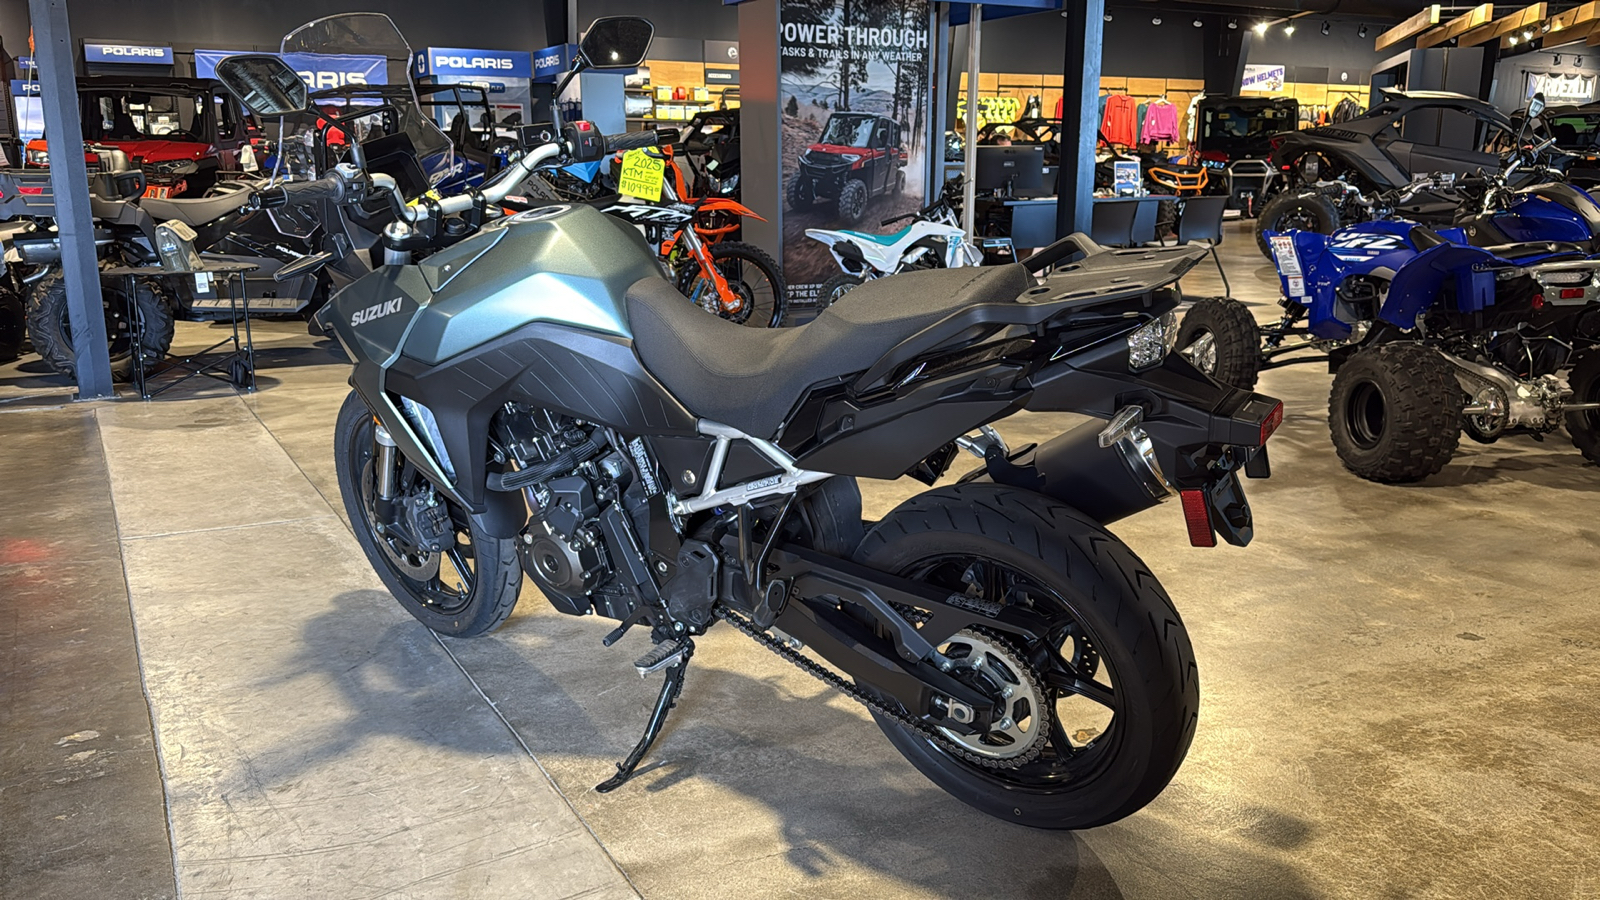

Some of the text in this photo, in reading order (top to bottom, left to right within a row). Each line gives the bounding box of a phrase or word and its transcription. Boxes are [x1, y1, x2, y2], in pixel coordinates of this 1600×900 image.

[845, 26, 927, 49] THROUGH
[102, 46, 165, 57] POLARIS
[781, 46, 923, 63] ASKS & TRAILS IN ANY WEATHER
[435, 55, 514, 70] POLARIS
[534, 54, 560, 70] POLARIS
[1256, 67, 1283, 83] HELMETS
[634, 156, 662, 171] 2025
[623, 167, 643, 179] KTM
[351, 297, 403, 327] SUZUKI
